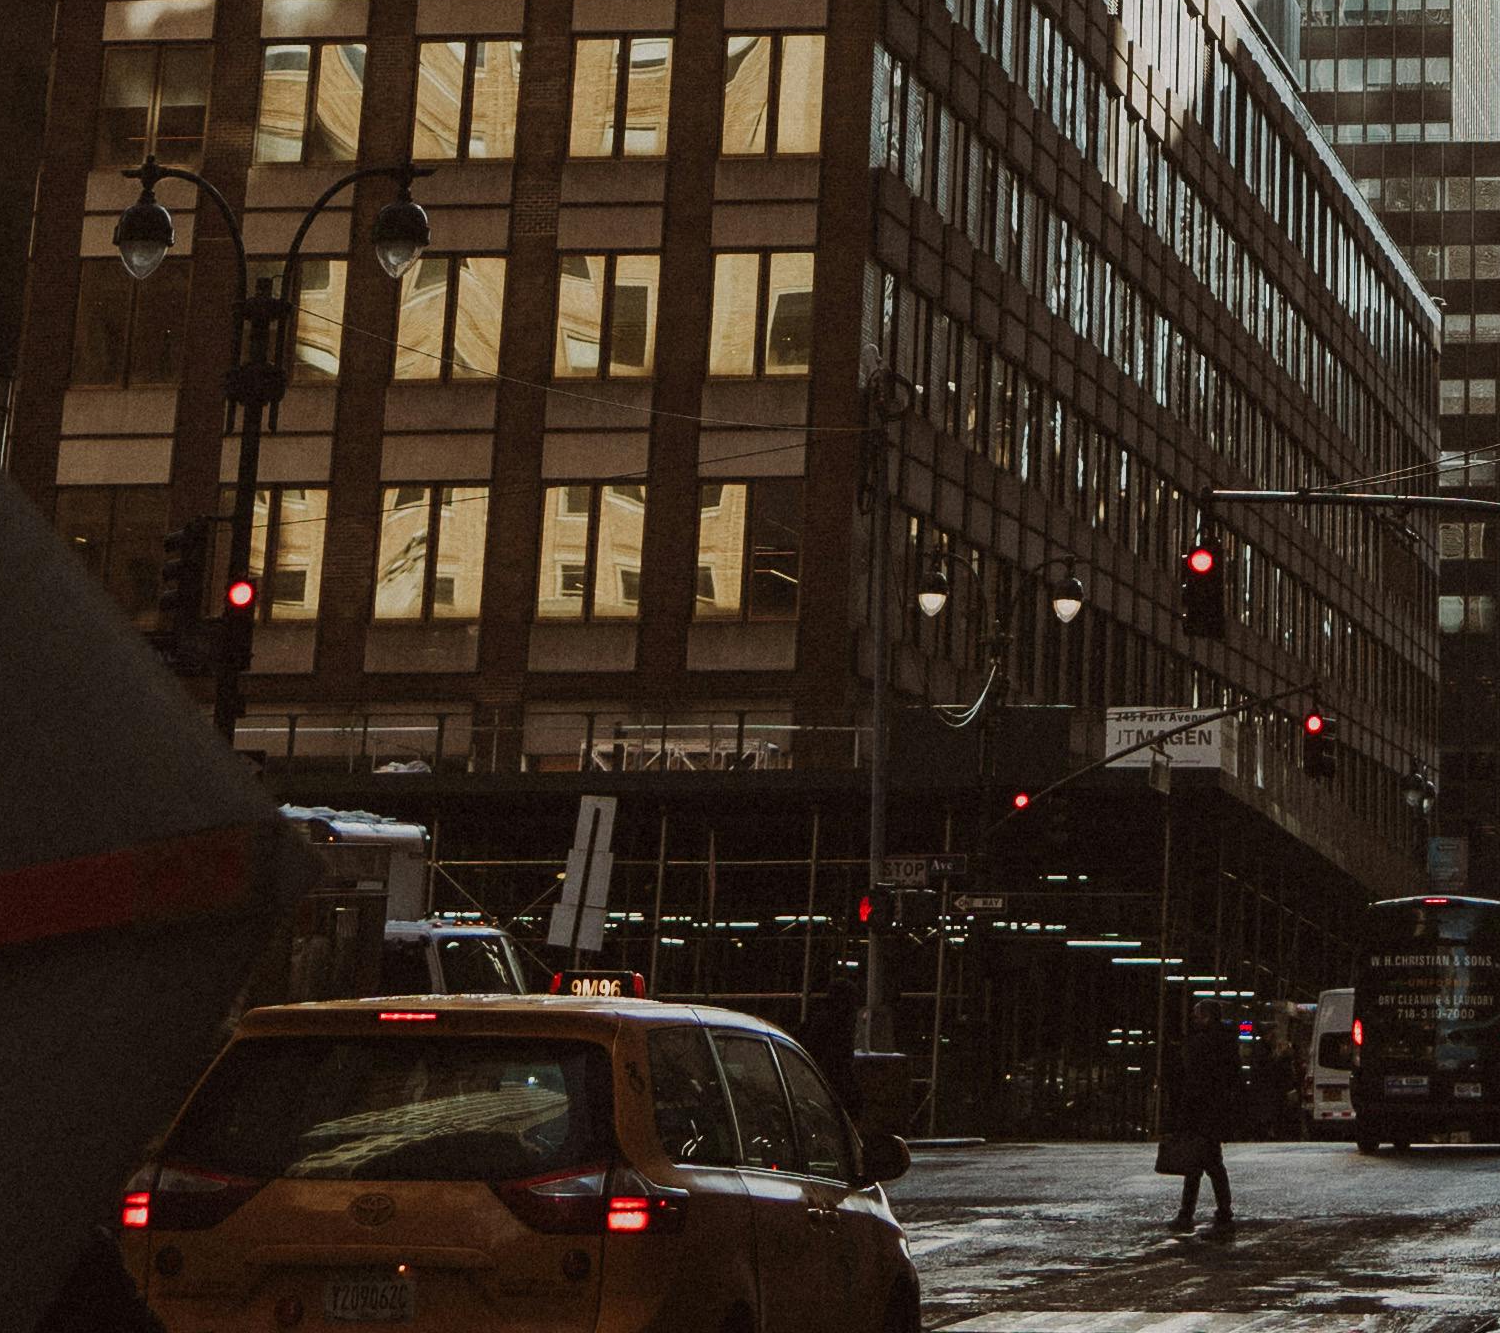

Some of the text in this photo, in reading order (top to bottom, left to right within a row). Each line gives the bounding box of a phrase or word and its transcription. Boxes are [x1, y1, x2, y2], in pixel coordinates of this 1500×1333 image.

[1139, 712, 1165, 722] Park
[883, 862, 925, 876] STOP
[931, 860, 953, 870] Ave
[571, 978, 621, 997] 9M96
